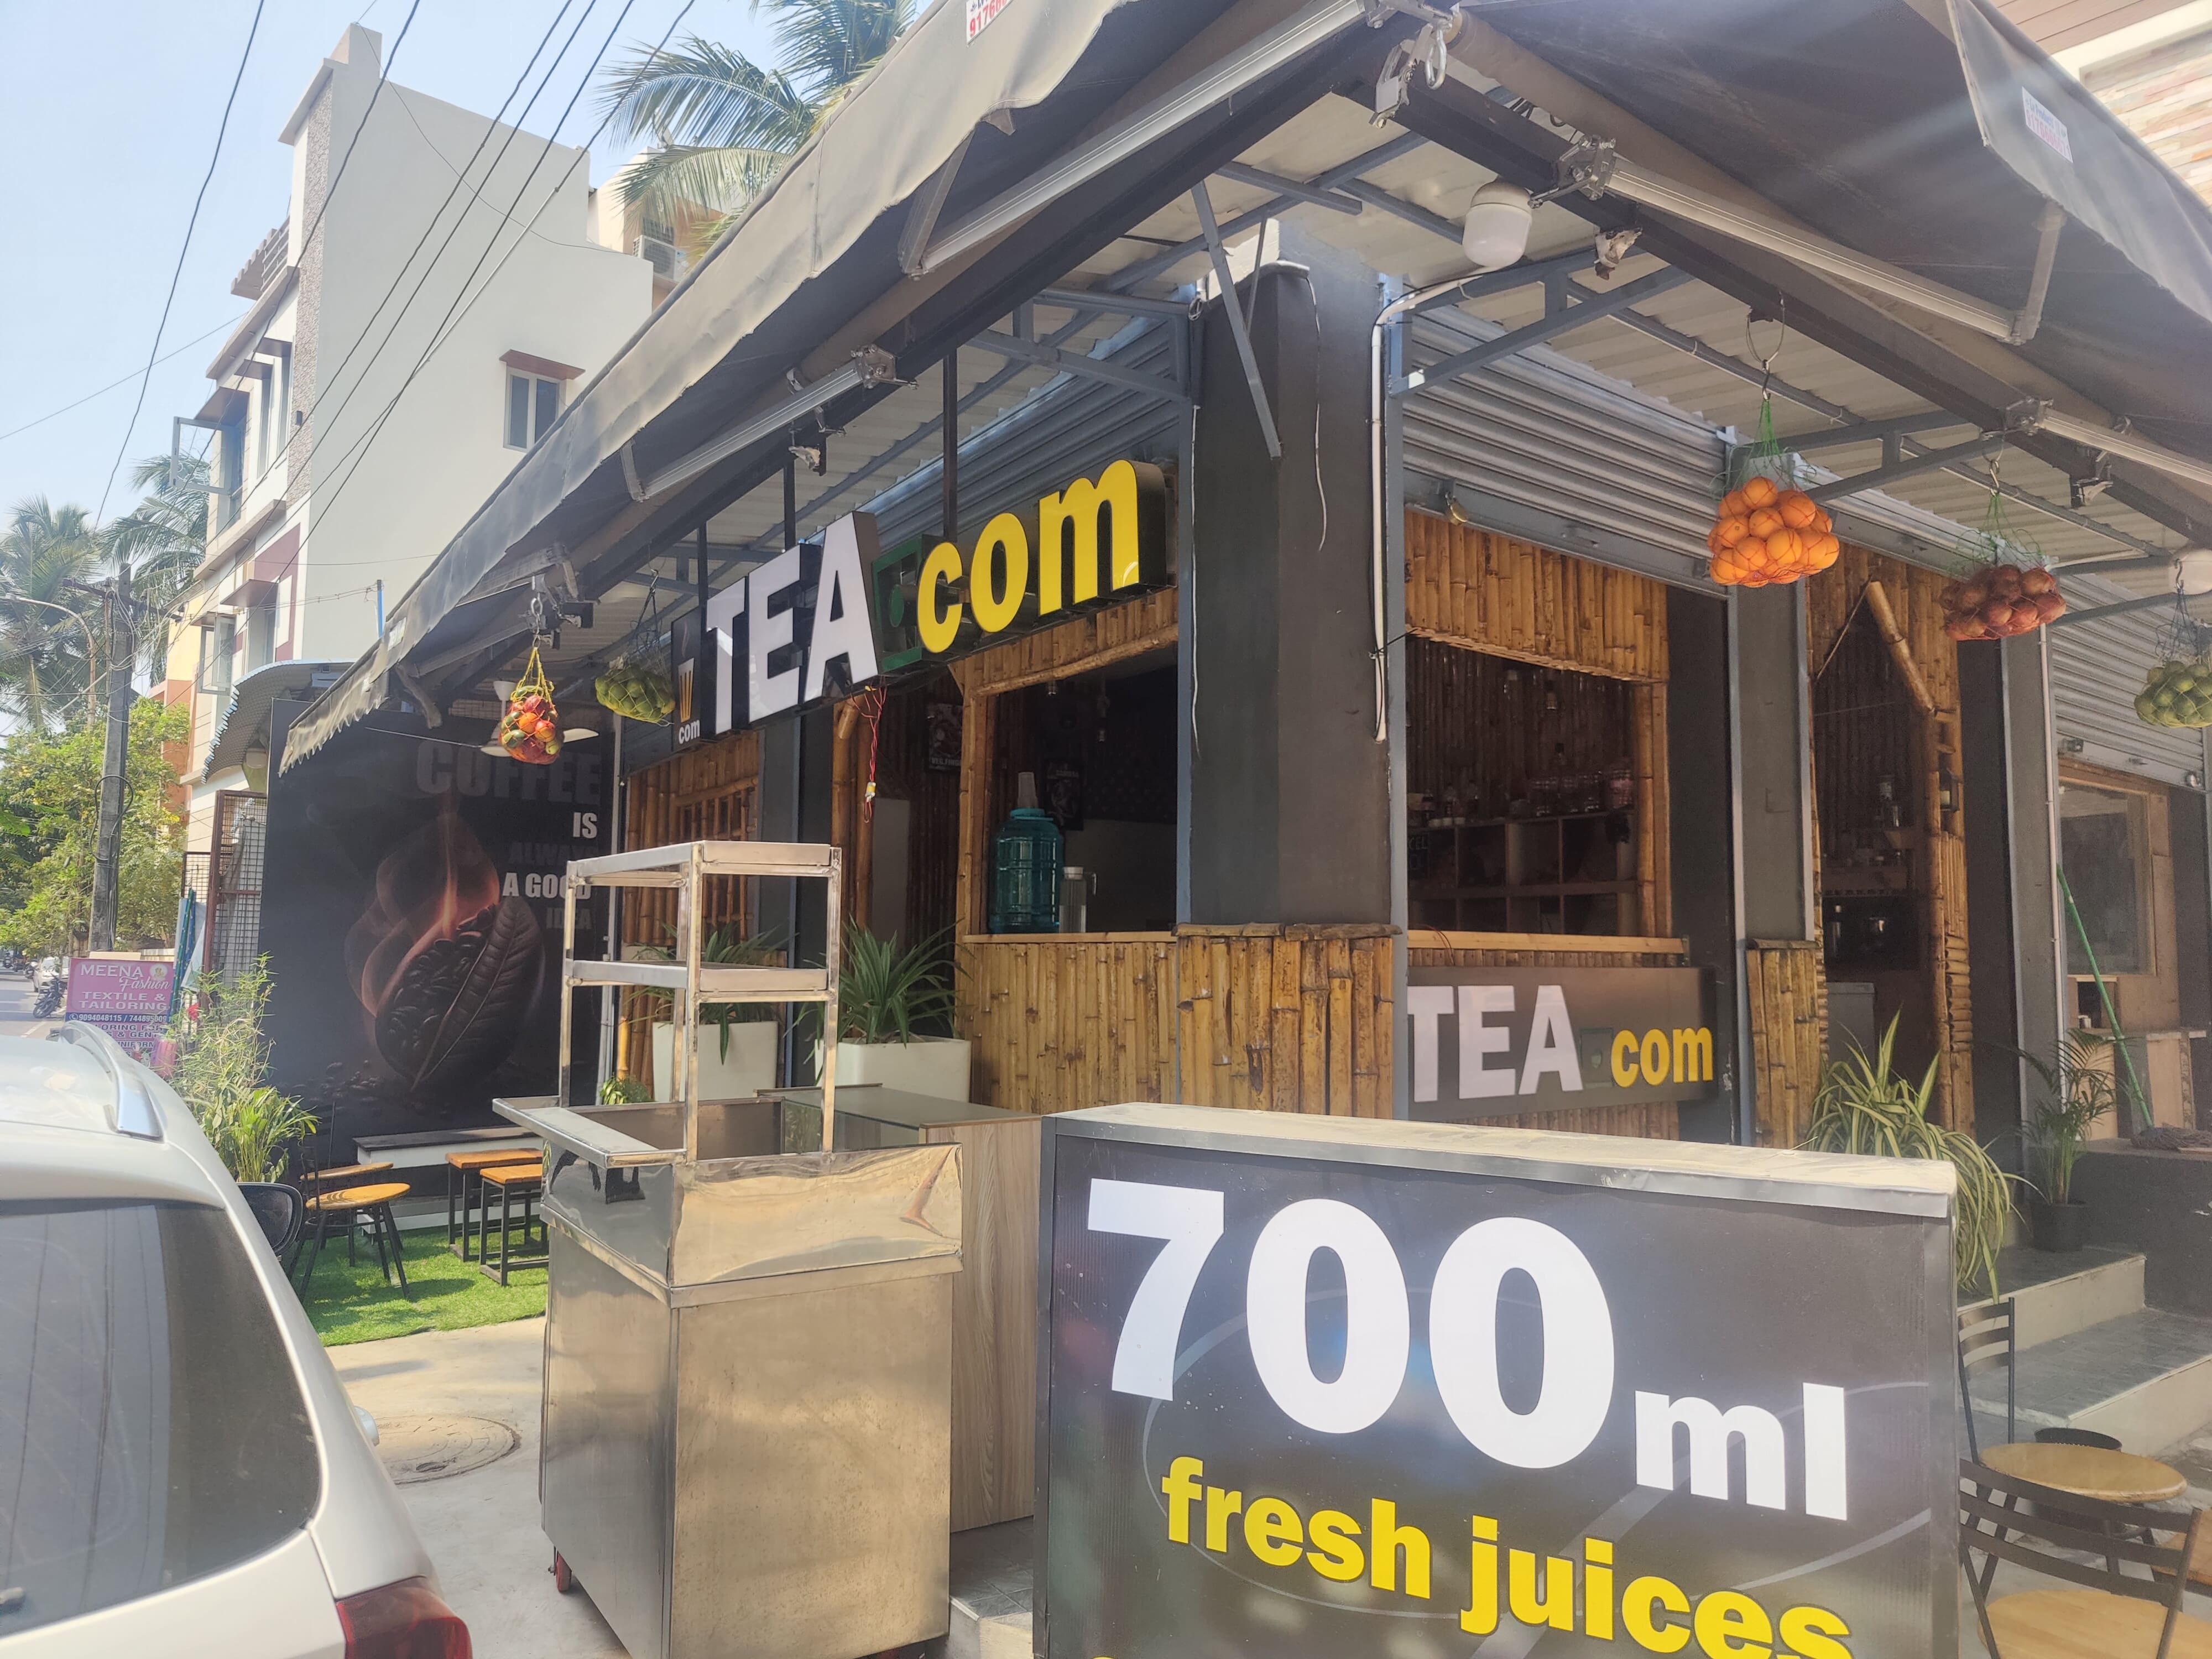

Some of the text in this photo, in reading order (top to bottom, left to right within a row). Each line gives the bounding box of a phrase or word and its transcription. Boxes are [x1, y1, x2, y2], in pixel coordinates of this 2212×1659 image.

[706, 459, 1139, 734] TEA com
[679, 719, 700, 744] com
[416, 740, 601, 806] COFFEE
[572, 811, 598, 839] IS
[507, 841, 599, 866] ALWA
[502, 872, 520, 897] A
[545, 907, 592, 930] IDA
[80, 964, 144, 978] MEENA
[82, 992, 165, 1001] TEXTILE &
[118, 975, 170, 993] Fashion
[79, 1000, 168, 1011] TAILORING
[79, 1014, 122, 1022] 9094048115
[1407, 984, 1713, 1103] TEA com
[1087, 1177, 1848, 1521] 700 ml
[1160, 1455, 1854, 1659] fresh juices
